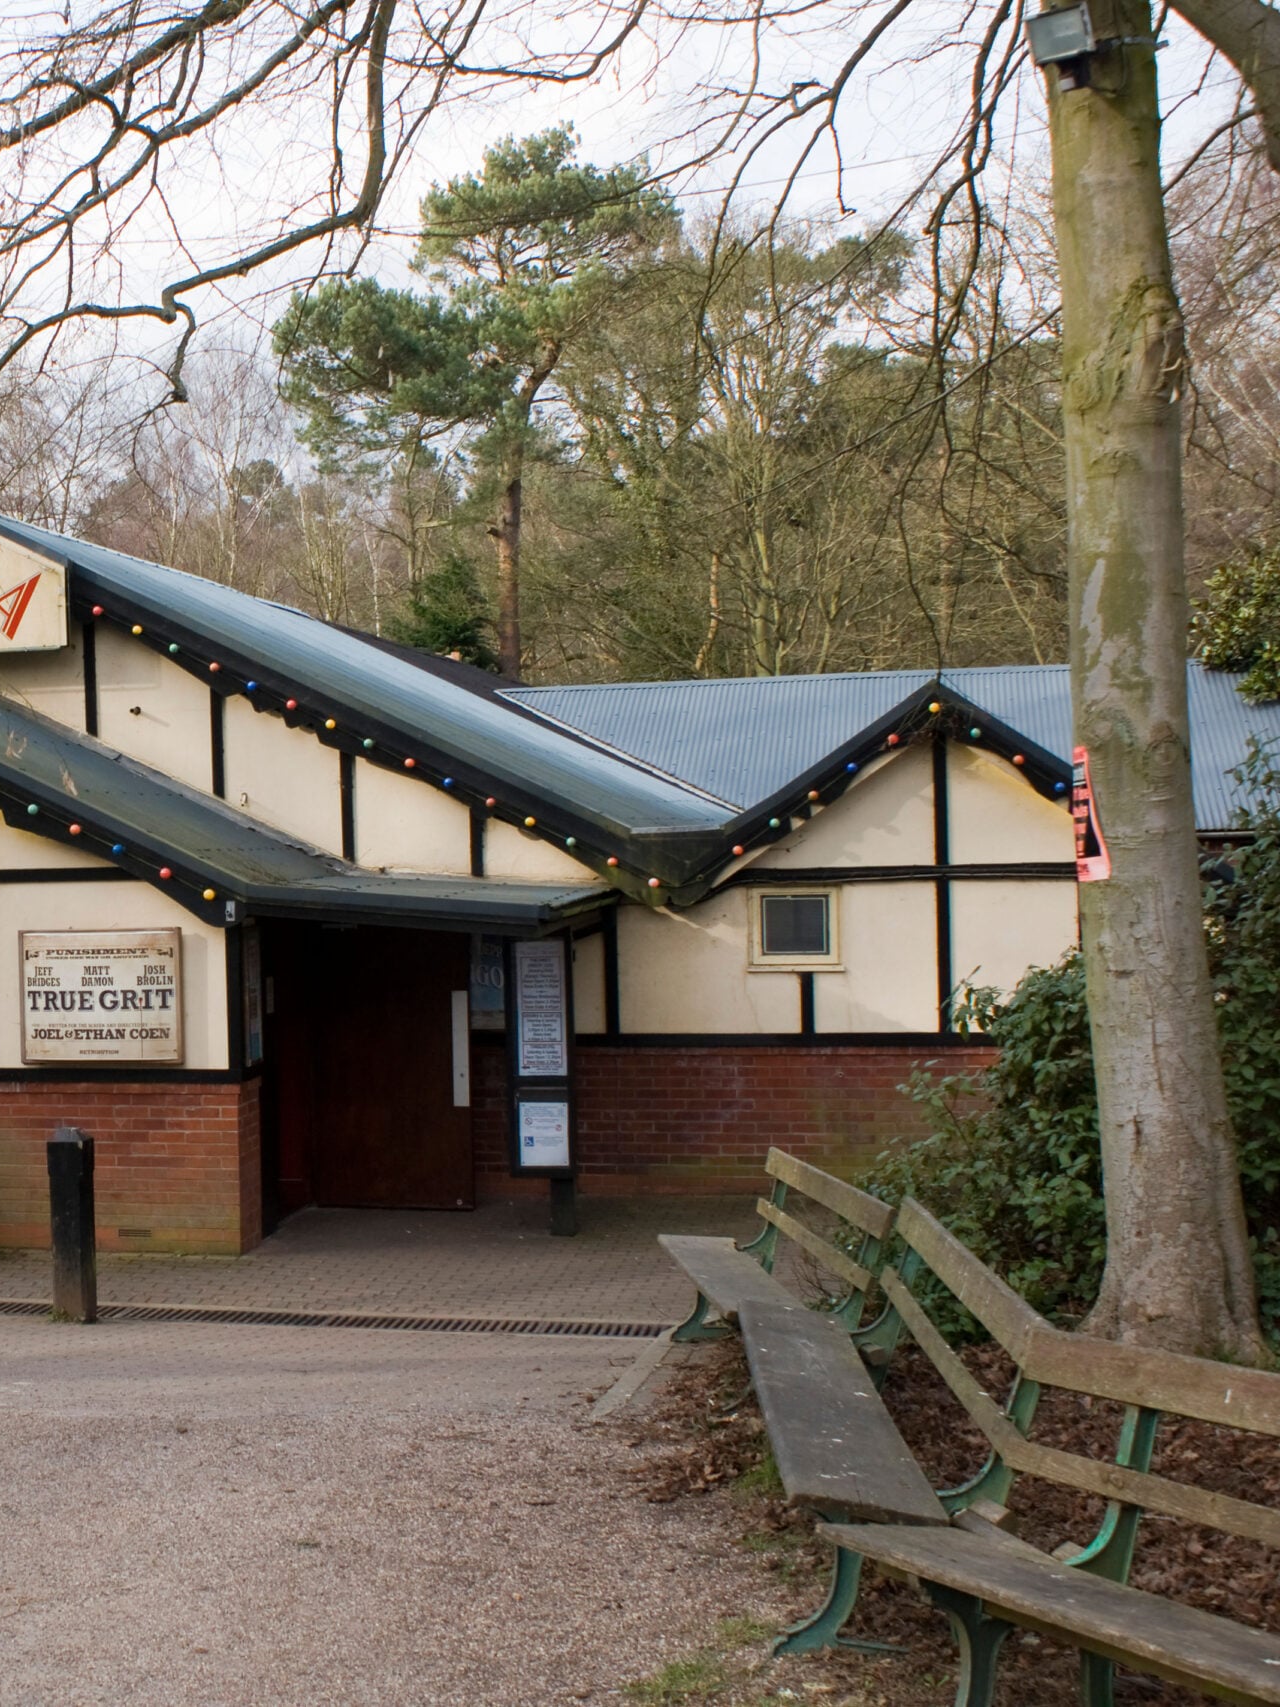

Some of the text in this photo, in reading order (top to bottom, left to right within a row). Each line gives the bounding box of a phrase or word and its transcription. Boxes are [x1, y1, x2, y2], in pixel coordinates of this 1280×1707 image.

[45, 947, 149, 956] PUNISHMENT
[34, 966, 54, 977] JEFF
[83, 965, 111, 976] MATT
[143, 965, 166, 976] JOSH
[27, 977, 61, 987] BRIDGES
[81, 977, 114, 987] DAMON
[136, 975, 174, 986] BROLIN
[27, 988, 174, 1011] TRUE GRIT
[31, 1028, 64, 1040] JOEL
[74, 1028, 126, 1040] ETHAN
[129, 1027, 171, 1040] COEN
